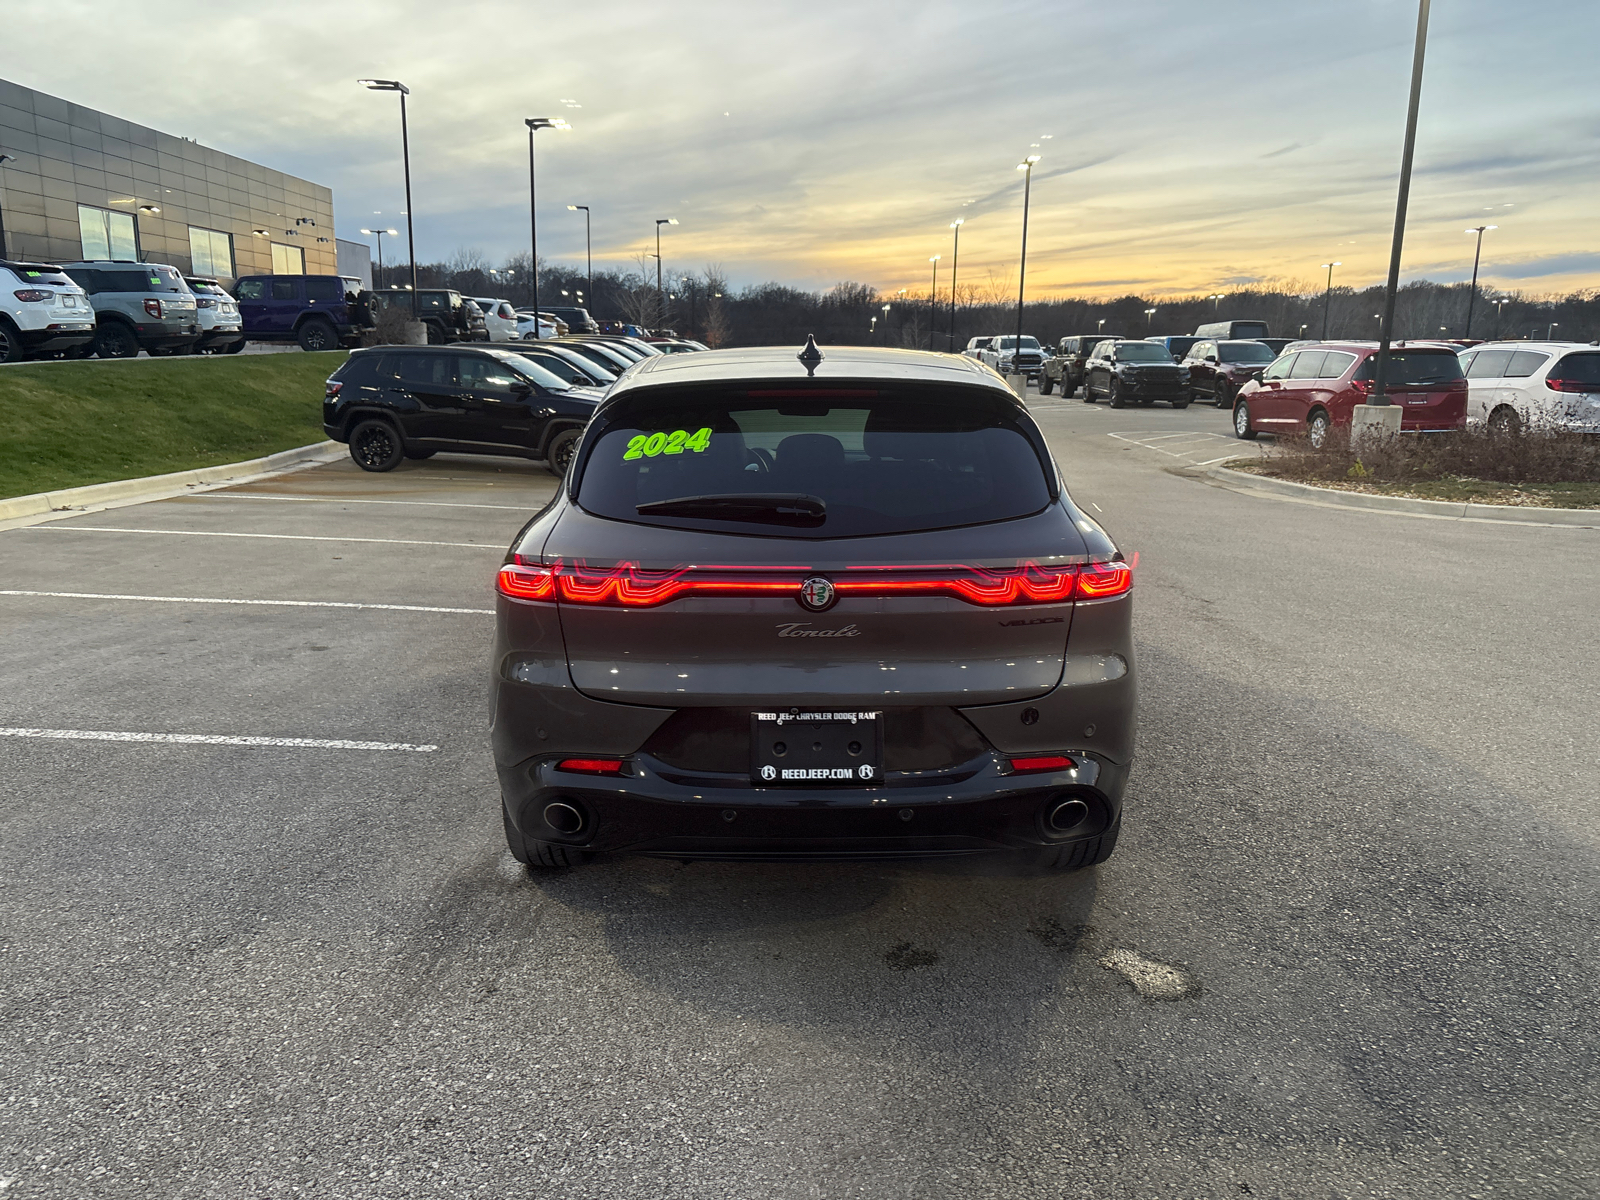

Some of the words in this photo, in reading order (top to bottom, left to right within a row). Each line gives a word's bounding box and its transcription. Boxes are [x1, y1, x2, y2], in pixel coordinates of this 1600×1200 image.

[623, 427, 713, 461] 2024
[775, 622, 862, 638] Tonale
[833, 712, 857, 720] DODGE
[858, 712, 876, 720] RAM
[781, 769, 853, 779] REEDJEEP.COM
